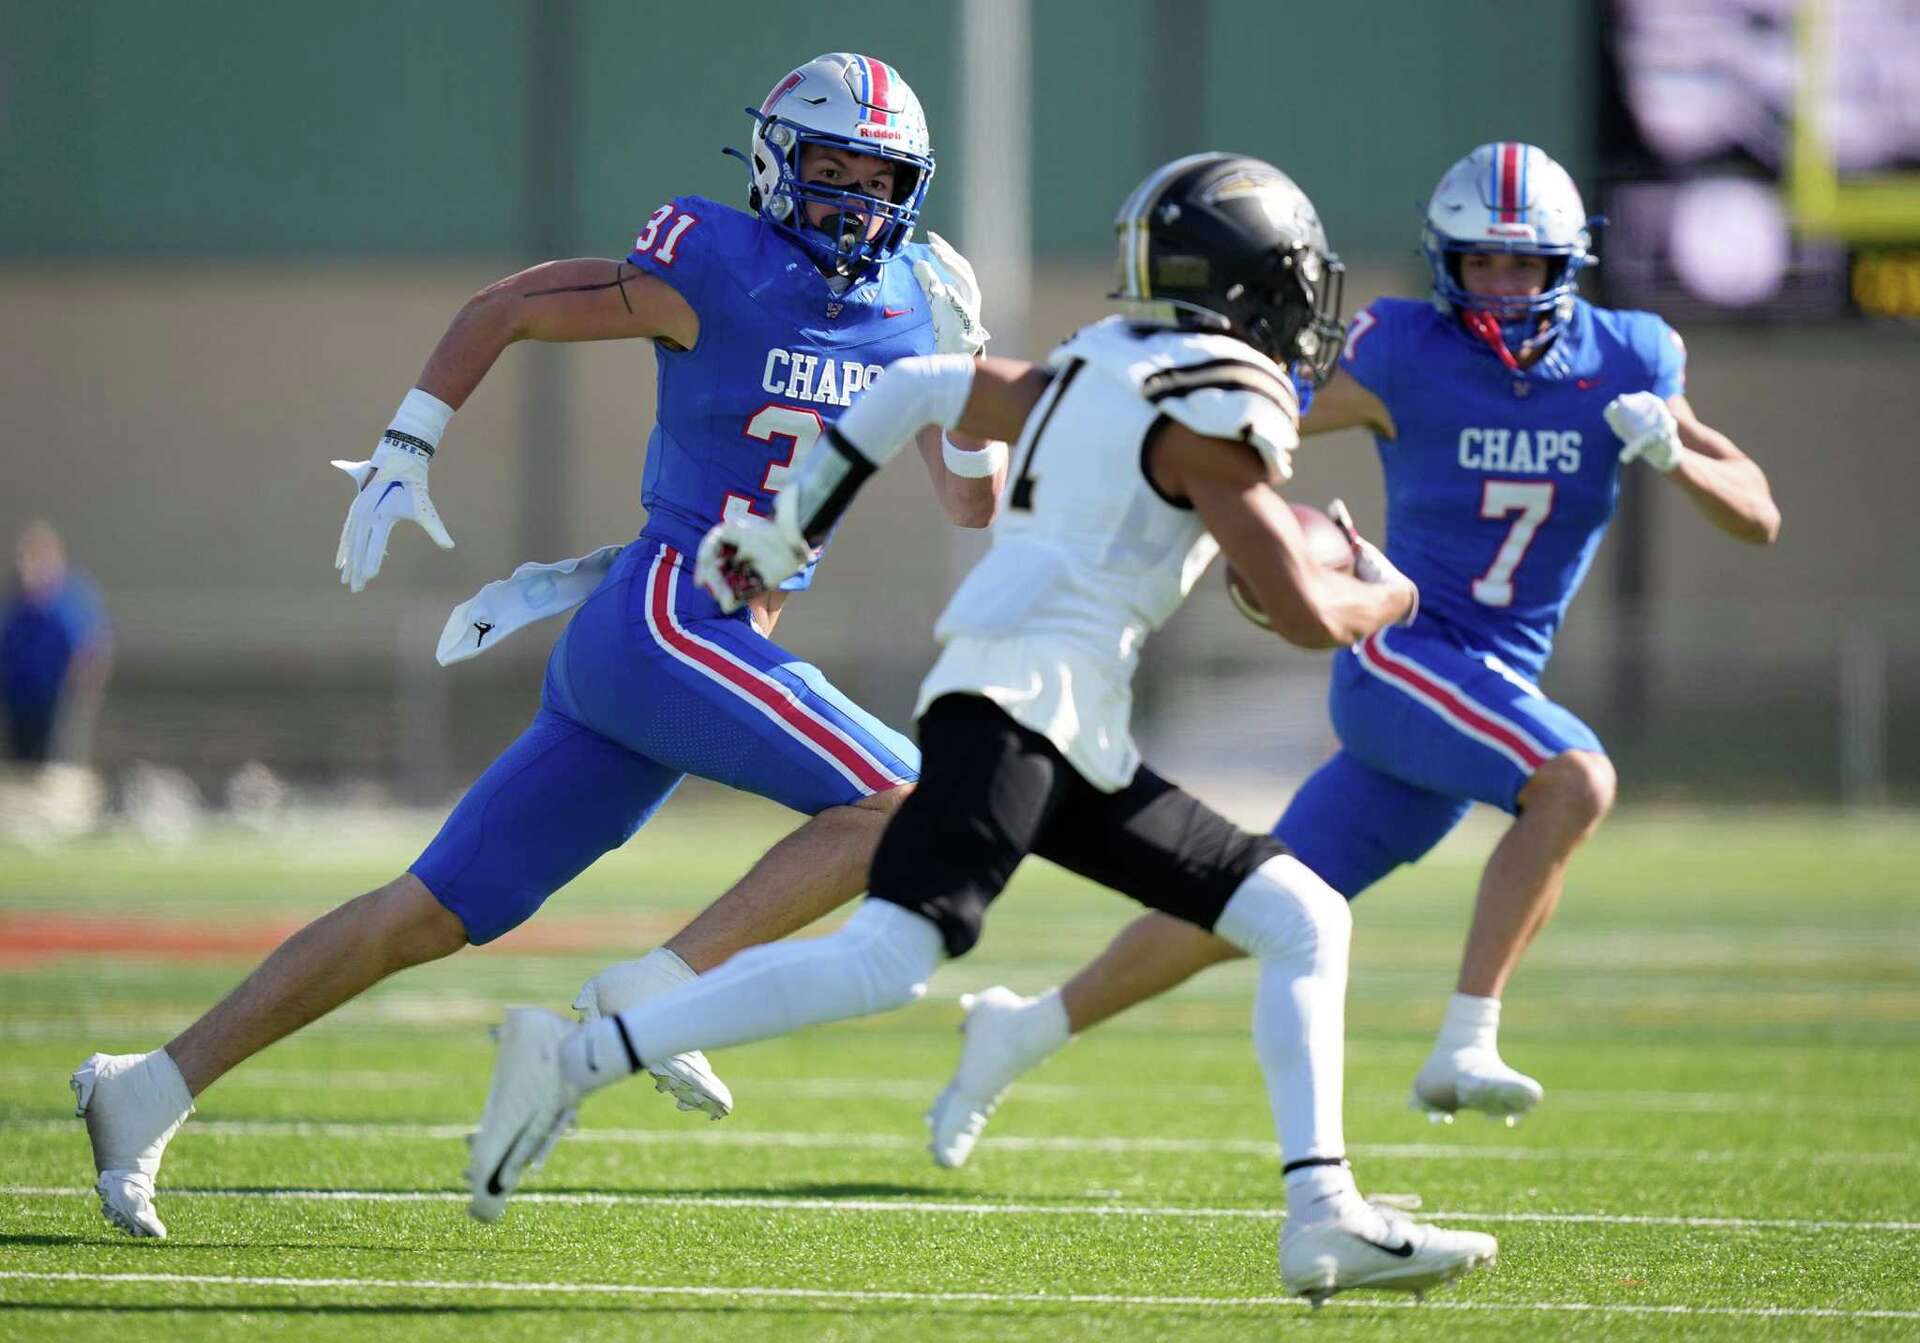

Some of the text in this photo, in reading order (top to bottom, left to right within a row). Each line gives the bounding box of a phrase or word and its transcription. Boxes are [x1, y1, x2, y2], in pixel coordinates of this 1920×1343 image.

[635, 203, 700, 266] 31
[1344, 308, 1376, 361] 7
[384, 437, 417, 455] DUKE
[720, 402, 826, 526] 3
[1458, 427, 1582, 473] CHAPS
[1472, 480, 1554, 605] 7
